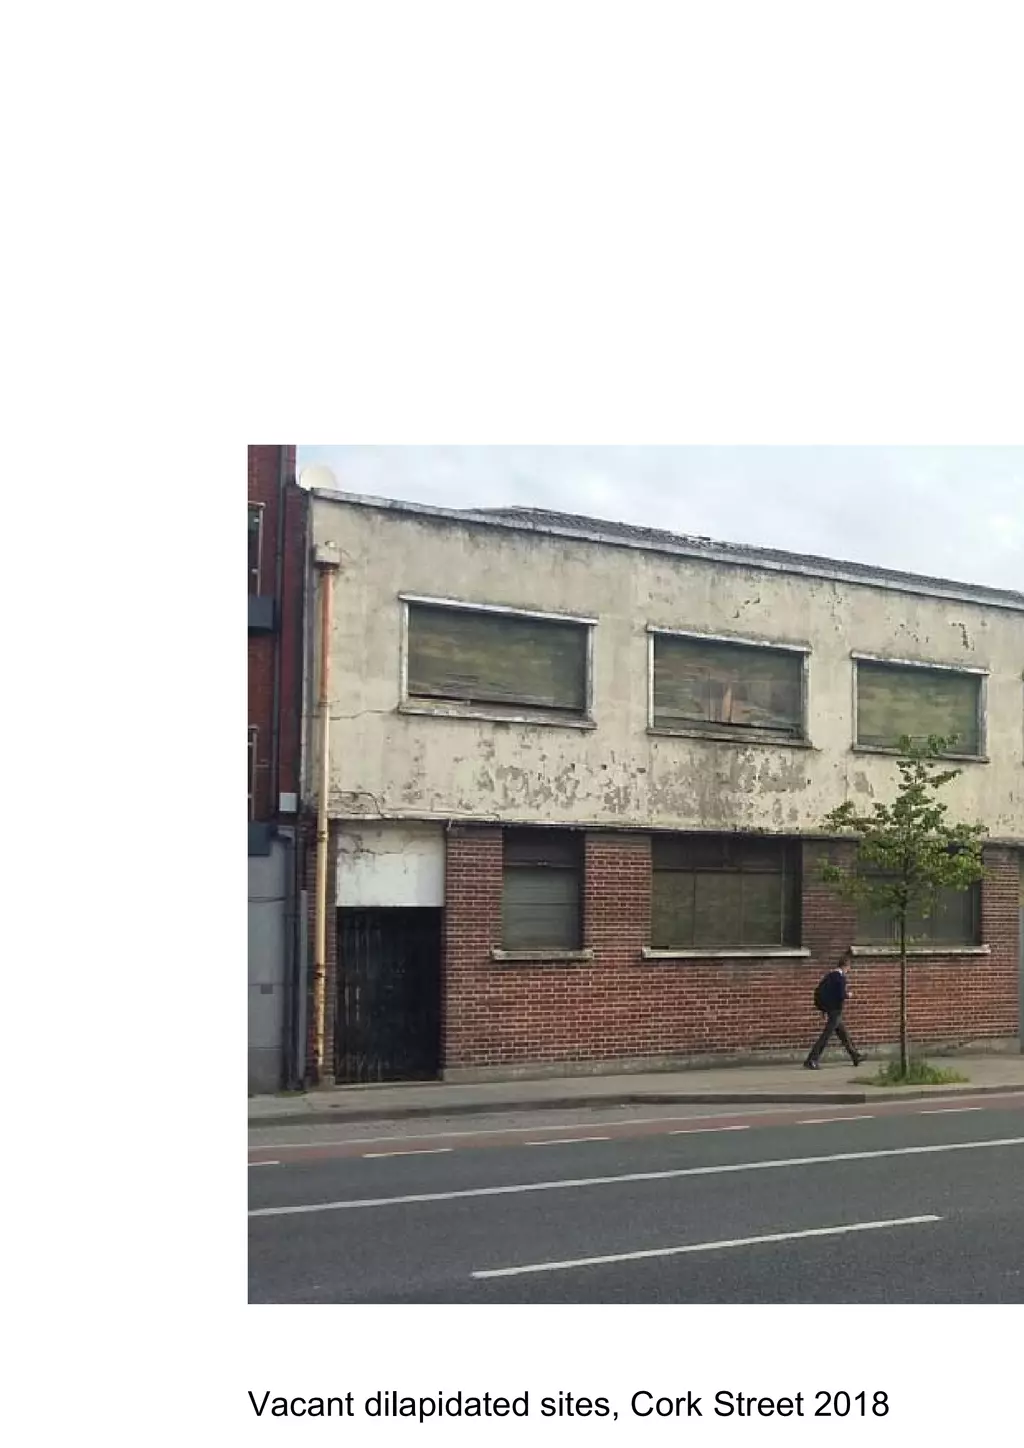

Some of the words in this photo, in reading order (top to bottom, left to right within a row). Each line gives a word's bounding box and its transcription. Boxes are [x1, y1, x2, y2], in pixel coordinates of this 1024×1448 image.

[247, 1390, 355, 1417] Vacant
[364, 1390, 529, 1424] dilapidated
[540, 1390, 618, 1421] sites,
[631, 1390, 703, 1417] Cork
[713, 1390, 805, 1417] Street
[814, 1390, 890, 1417] 2018
